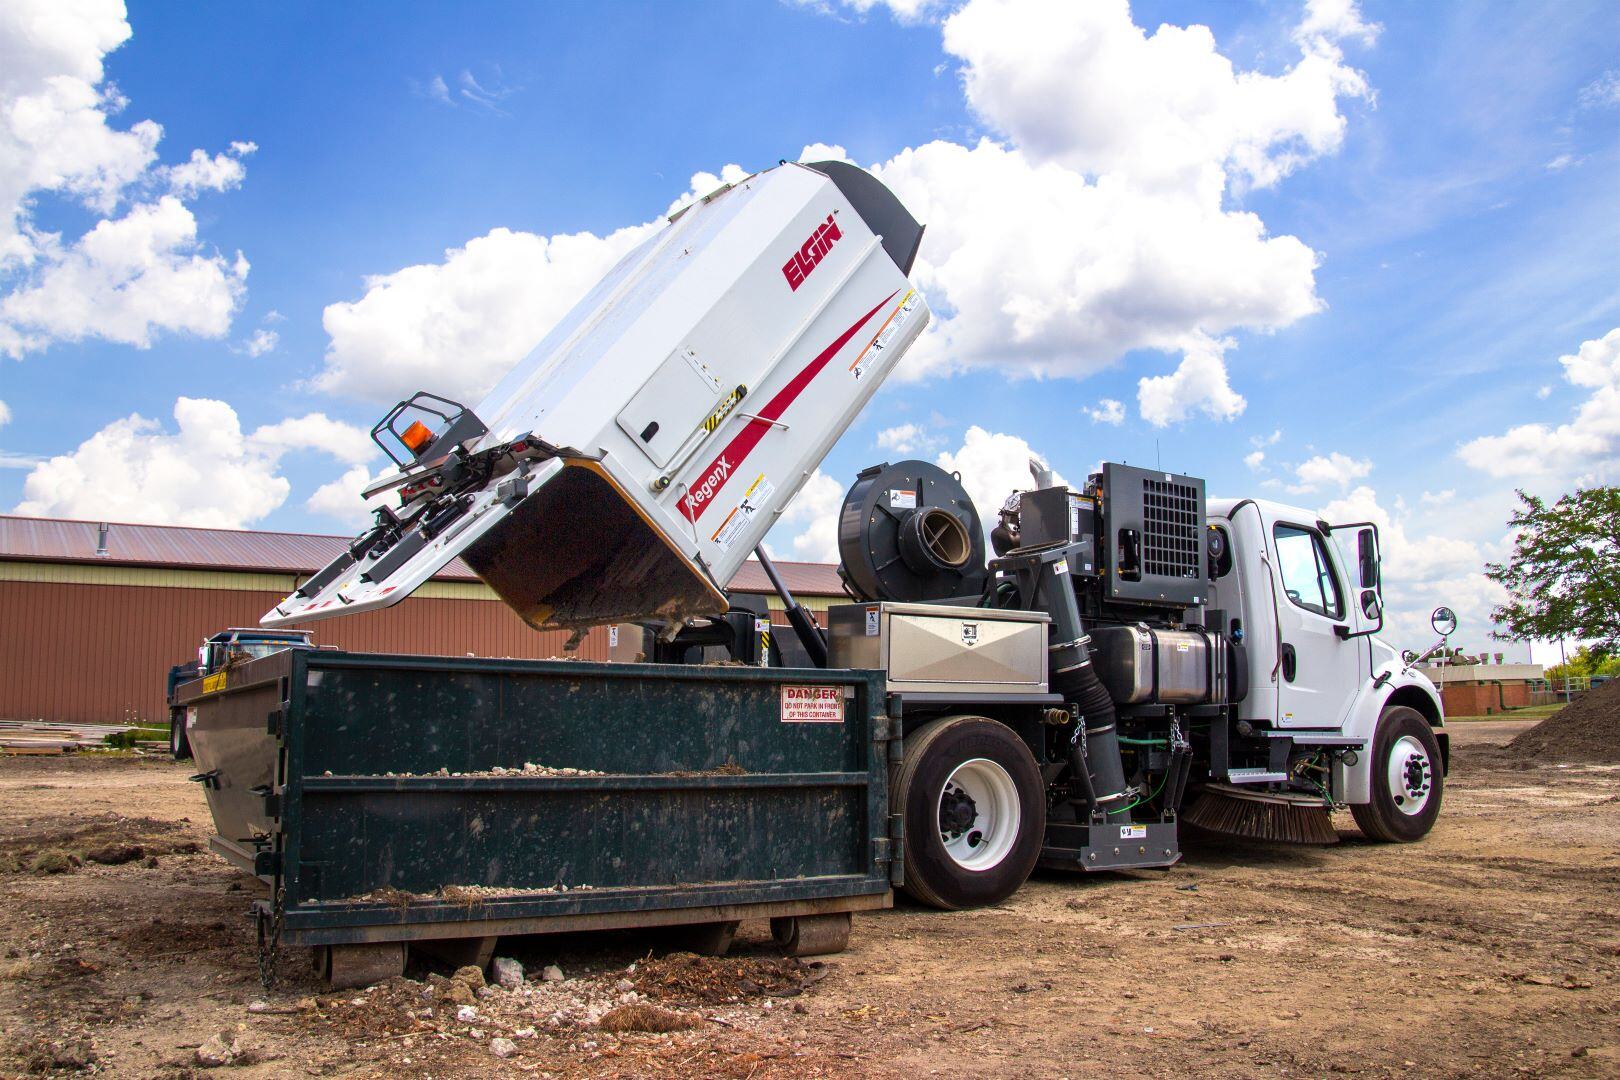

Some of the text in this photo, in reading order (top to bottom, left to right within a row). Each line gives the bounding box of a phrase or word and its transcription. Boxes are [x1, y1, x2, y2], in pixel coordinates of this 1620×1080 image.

[782, 213, 843, 292] ELGIN
[684, 455, 732, 512] RegenX
[788, 688, 838, 700] DANGER
